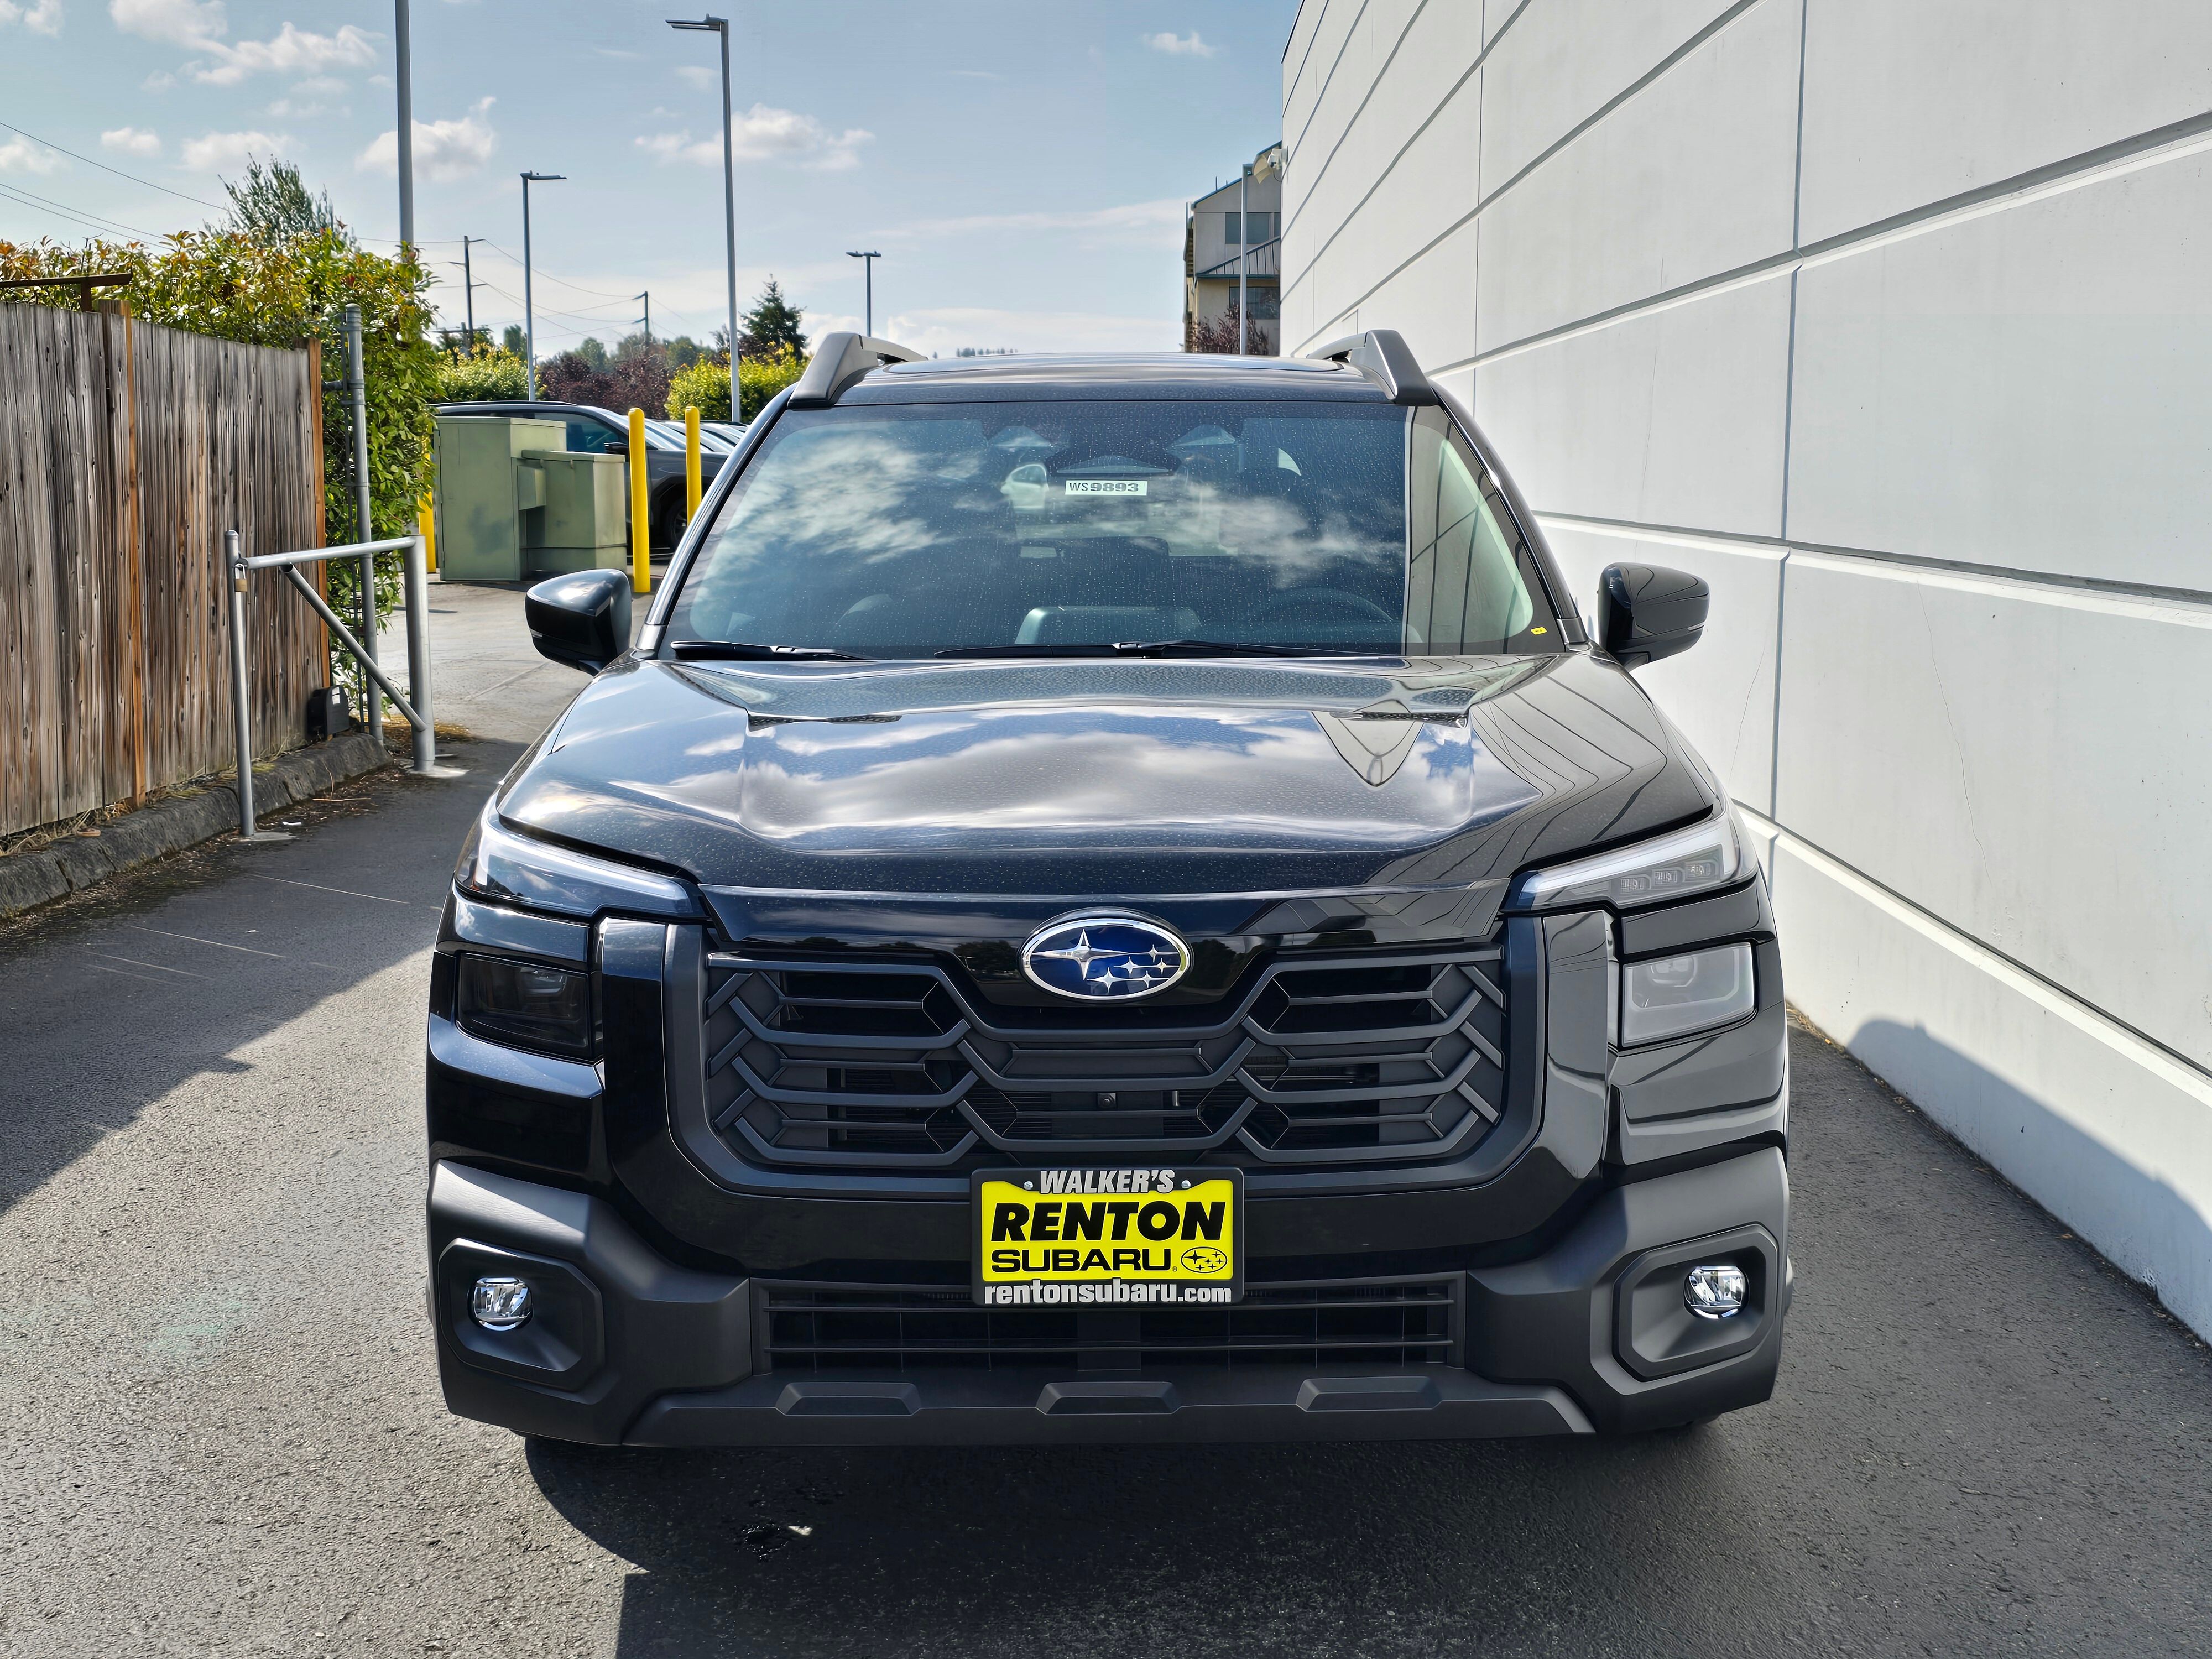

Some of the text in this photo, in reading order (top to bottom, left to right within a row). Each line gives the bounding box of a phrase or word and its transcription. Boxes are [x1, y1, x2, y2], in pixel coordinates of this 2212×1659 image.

[1040, 1170, 1175, 1193] WALKER'S
[991, 1201, 1226, 1241] RENTON
[991, 1248, 1171, 1271] SUBARU
[984, 1279, 1232, 1304] rentonsubaru.com
